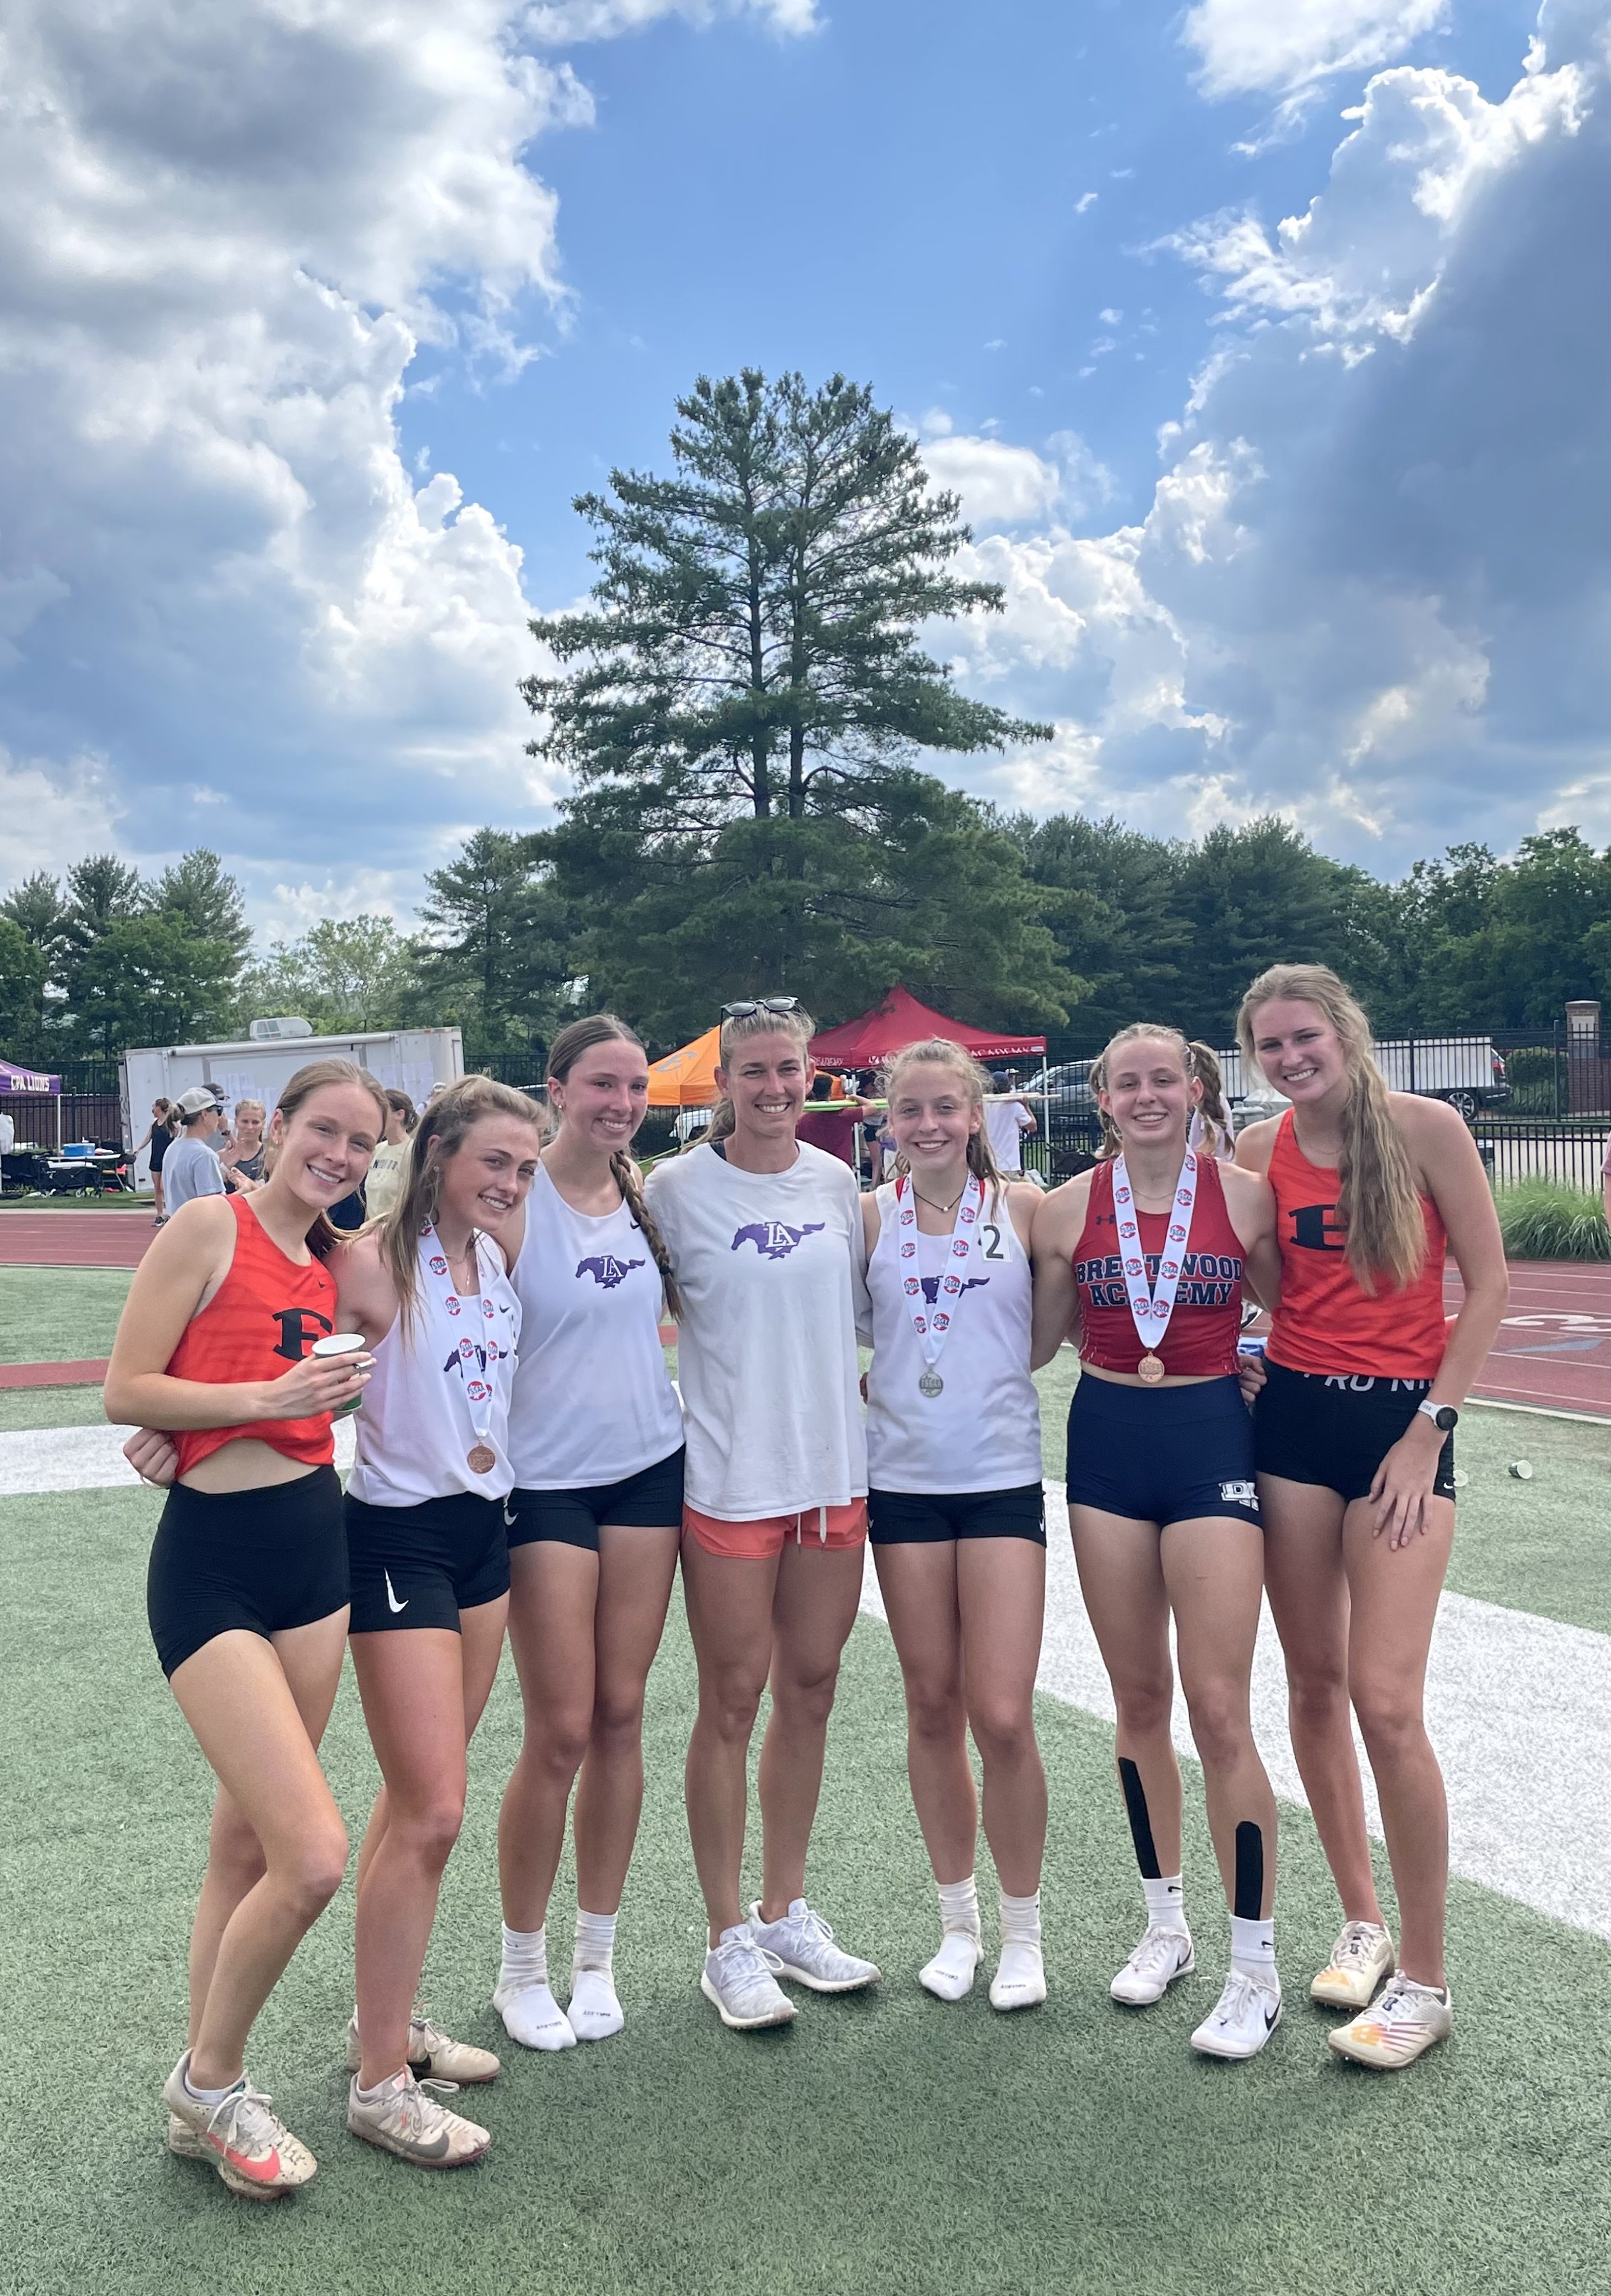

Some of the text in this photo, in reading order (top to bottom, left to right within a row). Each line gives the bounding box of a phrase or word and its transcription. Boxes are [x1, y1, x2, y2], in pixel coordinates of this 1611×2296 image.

[11, 1075, 50, 1092] CPA LIONS
[765, 1222, 798, 1248] LA
[983, 1224, 1004, 1260] 2
[600, 1256, 625, 1278] LA
[1076, 1253, 1242, 1284] BRETWOOD
[1125, 1263, 1143, 1271] TSSAA
[1162, 1264, 1179, 1273] TSSAA
[1088, 1281, 1234, 1307] ACEMY
[1133, 1302, 1150, 1310] TSSAA
